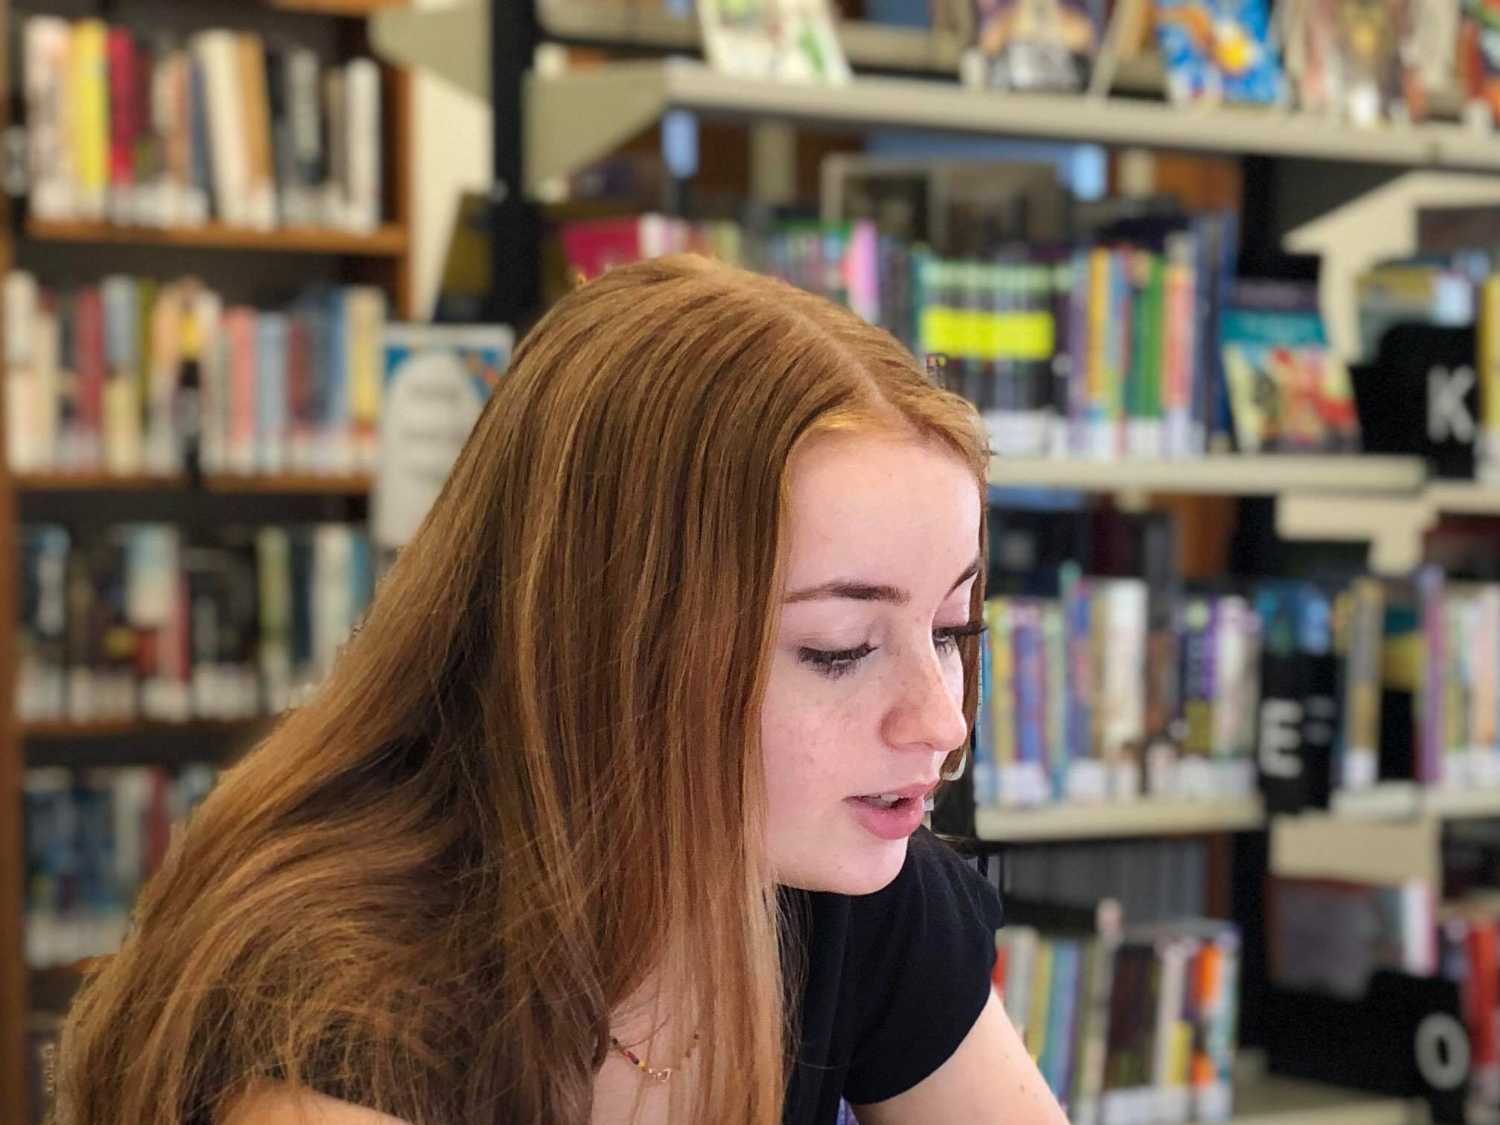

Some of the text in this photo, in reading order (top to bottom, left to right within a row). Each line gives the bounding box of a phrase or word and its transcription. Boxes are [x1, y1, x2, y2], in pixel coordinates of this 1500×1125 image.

[1426, 364, 1474, 443] K
[1260, 699, 1302, 777] E
[1416, 1012, 1468, 1090] O
